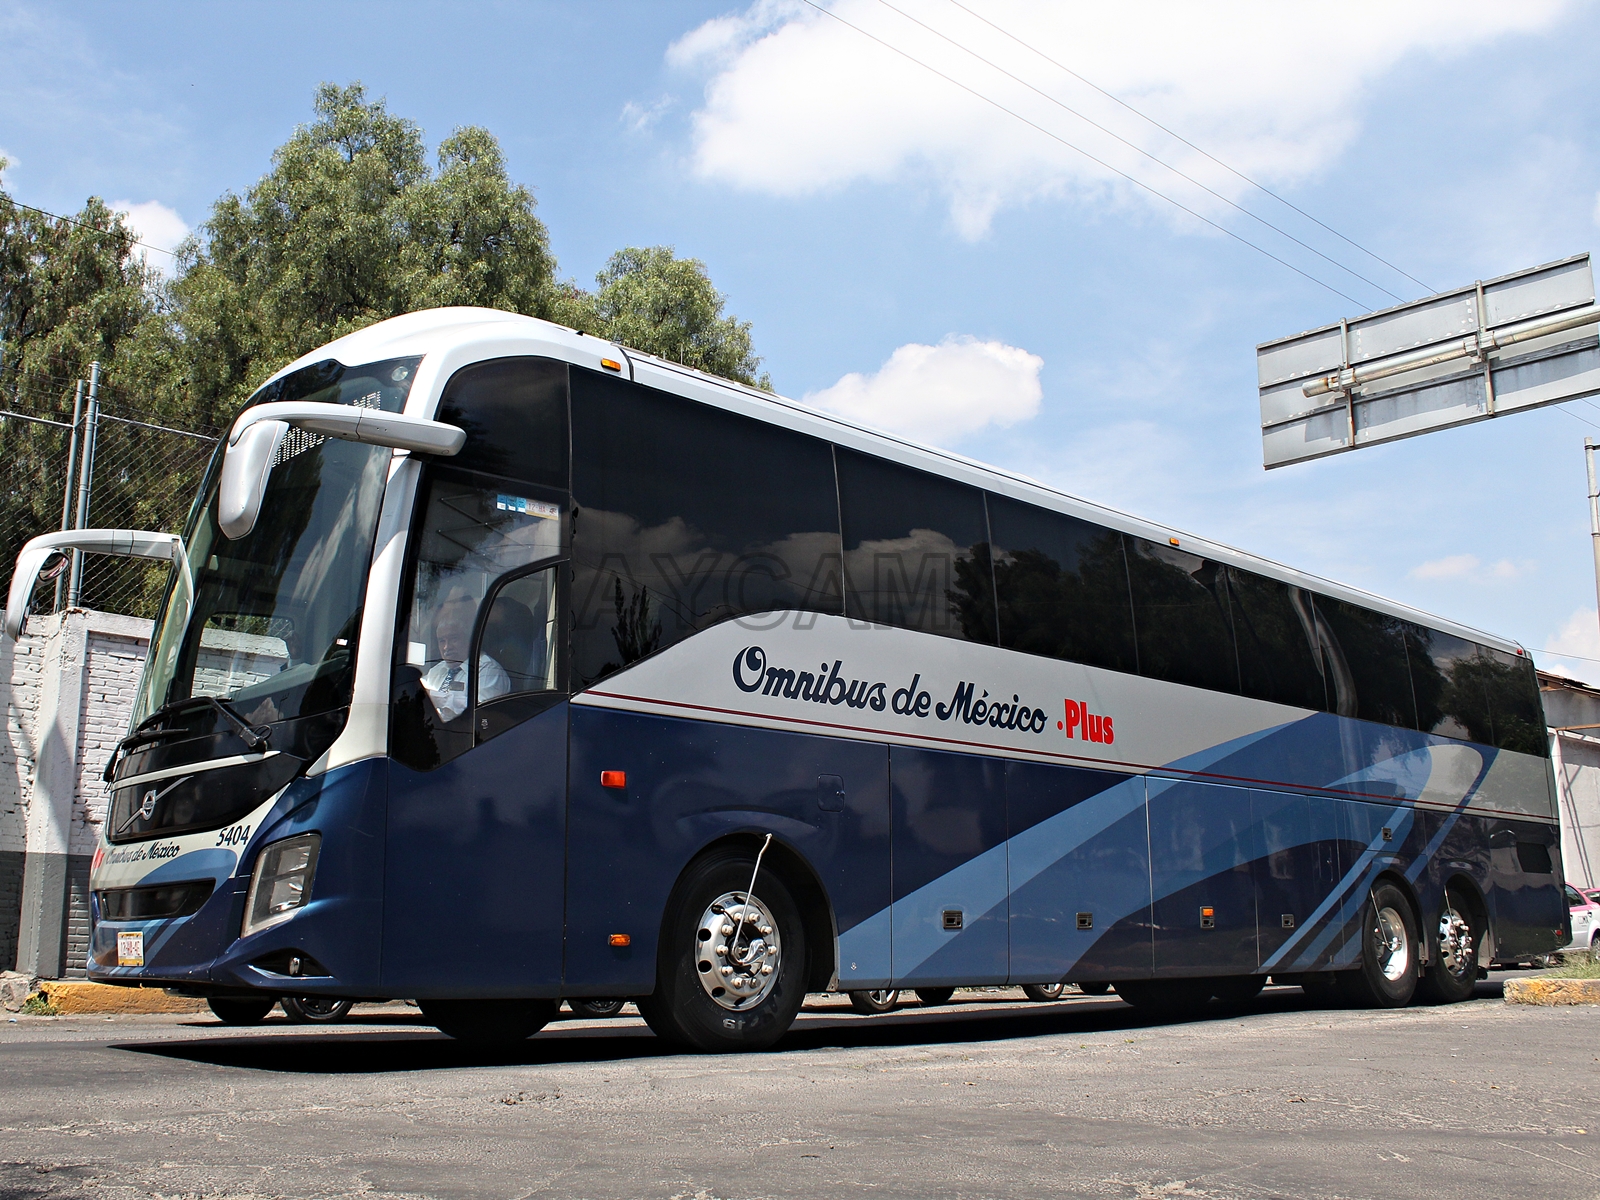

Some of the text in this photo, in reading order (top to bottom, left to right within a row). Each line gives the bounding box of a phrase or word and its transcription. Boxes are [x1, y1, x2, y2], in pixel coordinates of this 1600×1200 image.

[732, 645, 887, 712] Omnibus
[891, 673, 932, 718] de
[935, 680, 1049, 734] México
[215, 825, 251, 847] 5404
